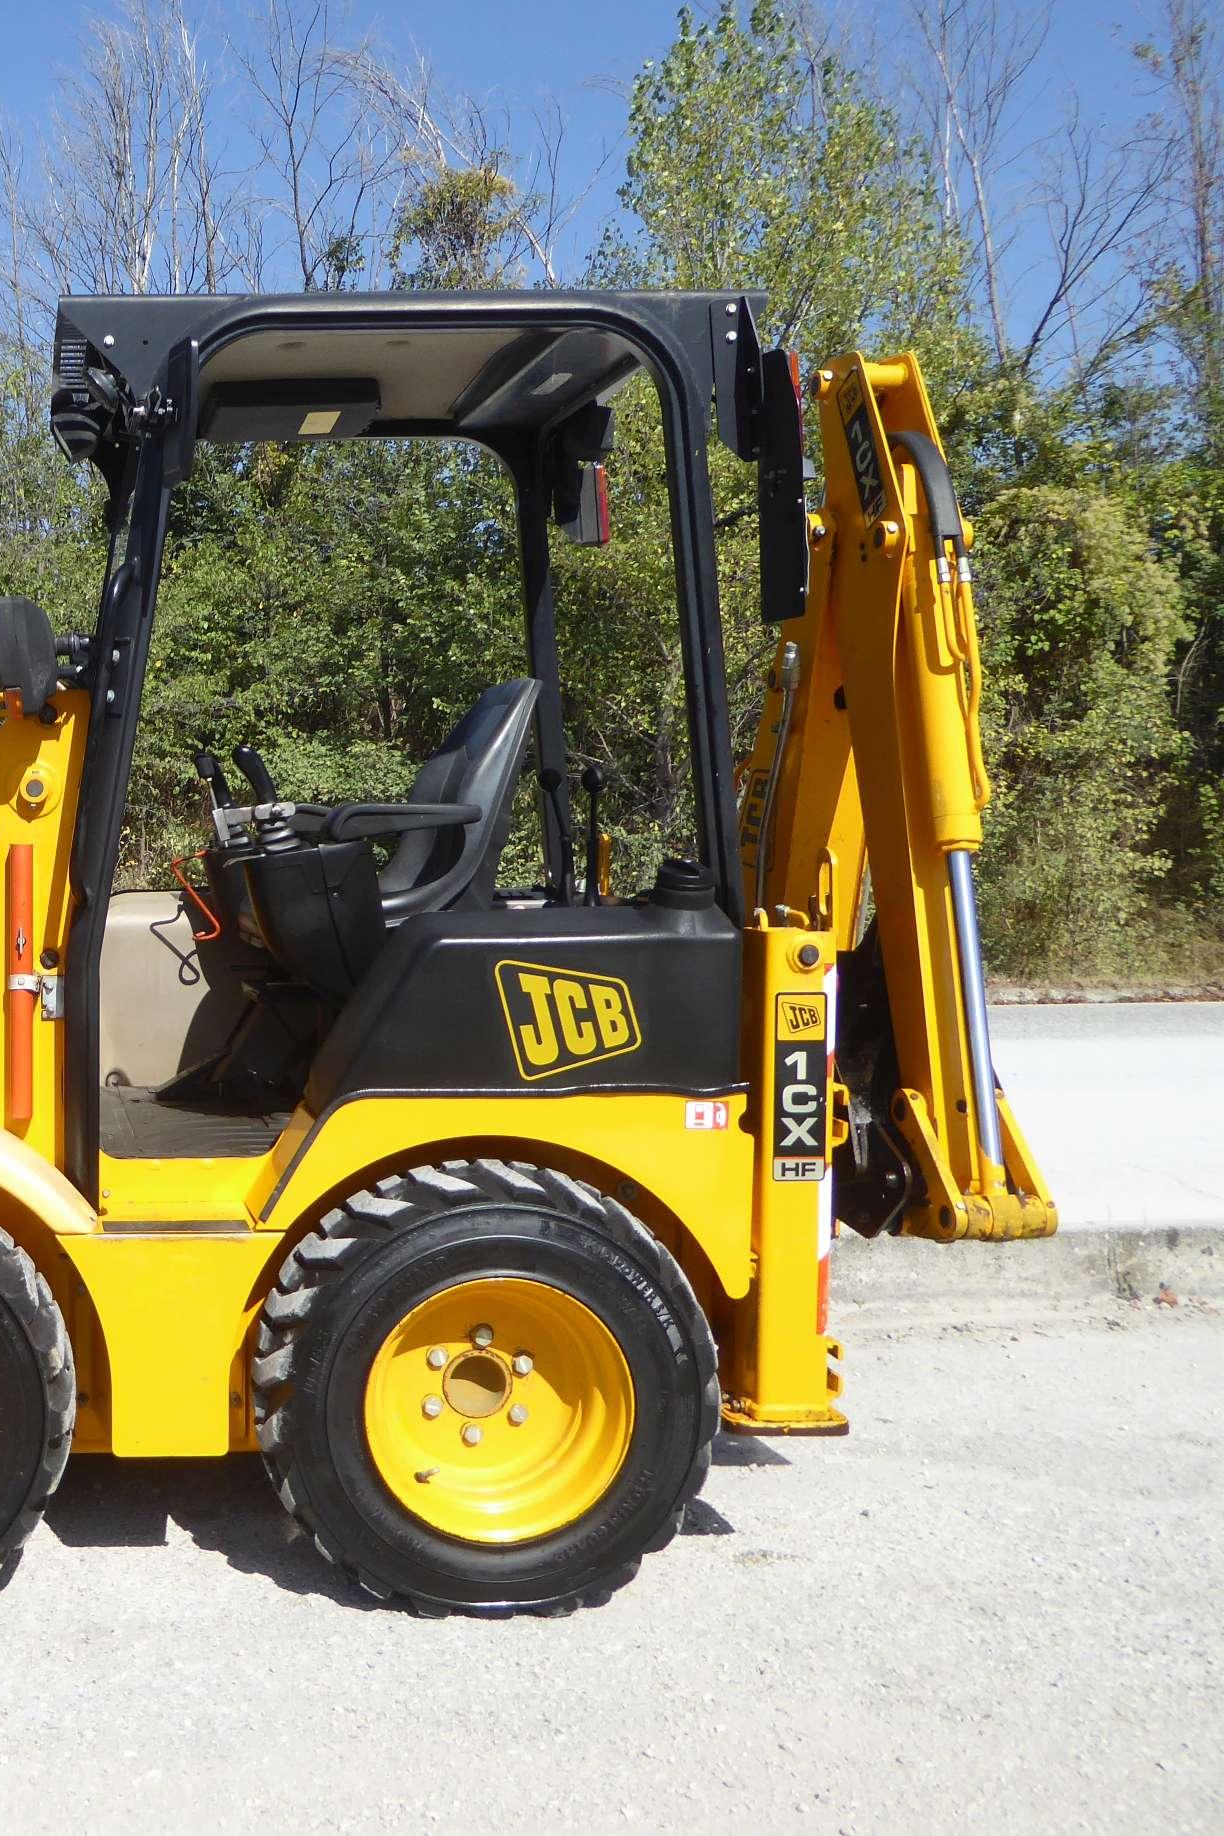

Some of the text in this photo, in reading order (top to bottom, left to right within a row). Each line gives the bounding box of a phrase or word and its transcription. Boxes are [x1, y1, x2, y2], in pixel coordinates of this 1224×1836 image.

[518, 972, 630, 1066] JCB
[789, 1004, 818, 1031] JCB
[779, 1051, 819, 1147] 1CX
[780, 1162, 816, 1177] HF
